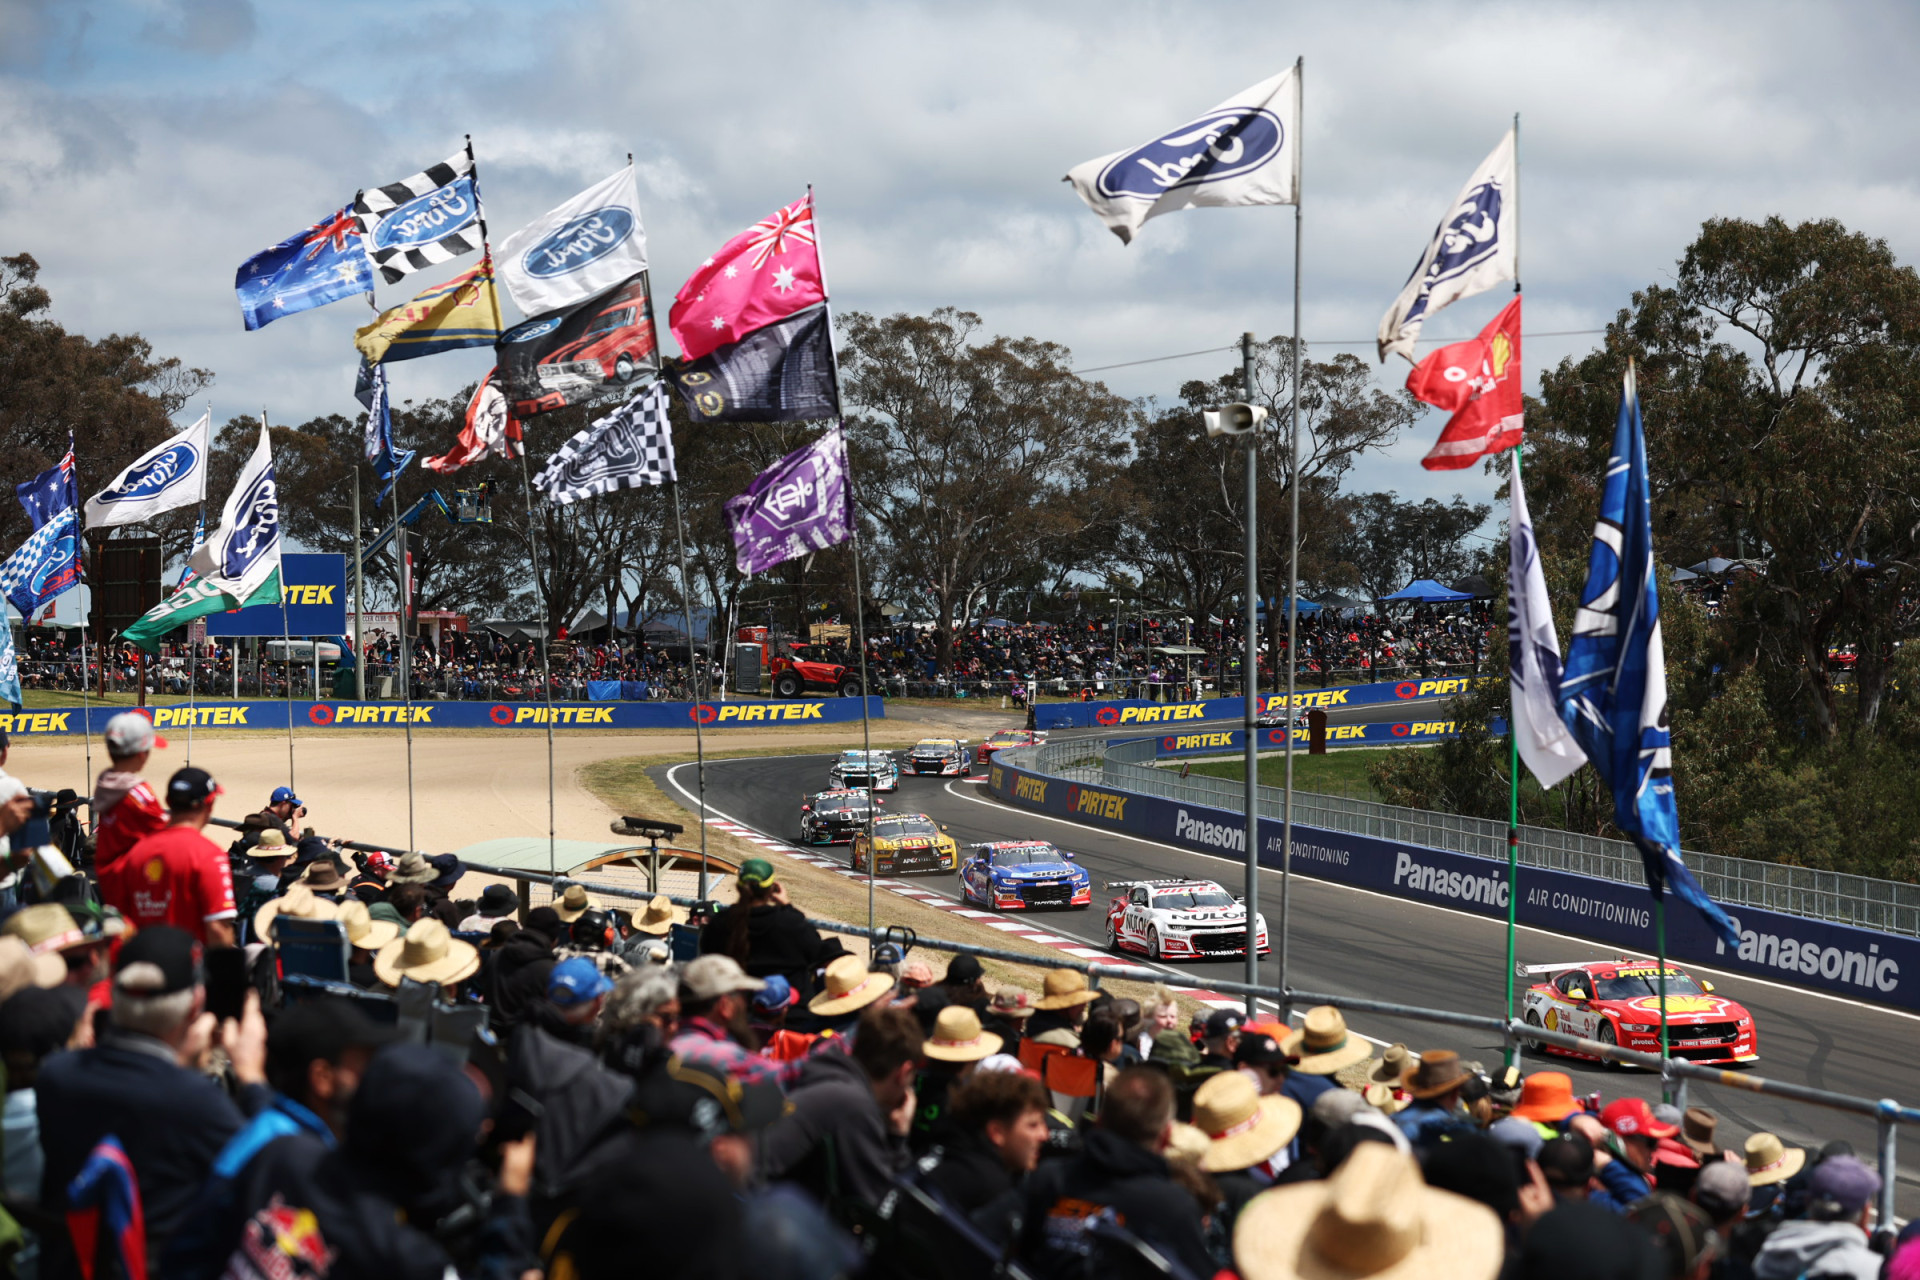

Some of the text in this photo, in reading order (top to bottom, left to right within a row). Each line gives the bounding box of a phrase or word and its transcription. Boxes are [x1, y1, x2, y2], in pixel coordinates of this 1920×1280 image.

[283, 585, 336, 605] RTEK
[1418, 678, 1470, 696] PIRT
[0, 712, 71, 732] RTEK
[154, 706, 250, 727] PIRTEK
[334, 705, 433, 724] PIRTEK
[515, 706, 617, 724] PIRTEK
[718, 703, 825, 722] PIRTEK
[1119, 703, 1206, 723] PIRTEK
[1290, 724, 1368, 742] PITEK
[1410, 722, 1457, 736] PIRT
[1175, 731, 1233, 750] PIRTEK
[1015, 775, 1048, 804] PIRTEK
[1077, 789, 1127, 821] PIRTEK
[882, 836, 945, 851] PENRITE
[1175, 808, 1350, 867] Panasoni AIR ONDITIONING
[1394, 852, 1650, 929] Panasonic AIR CONDITIONING
